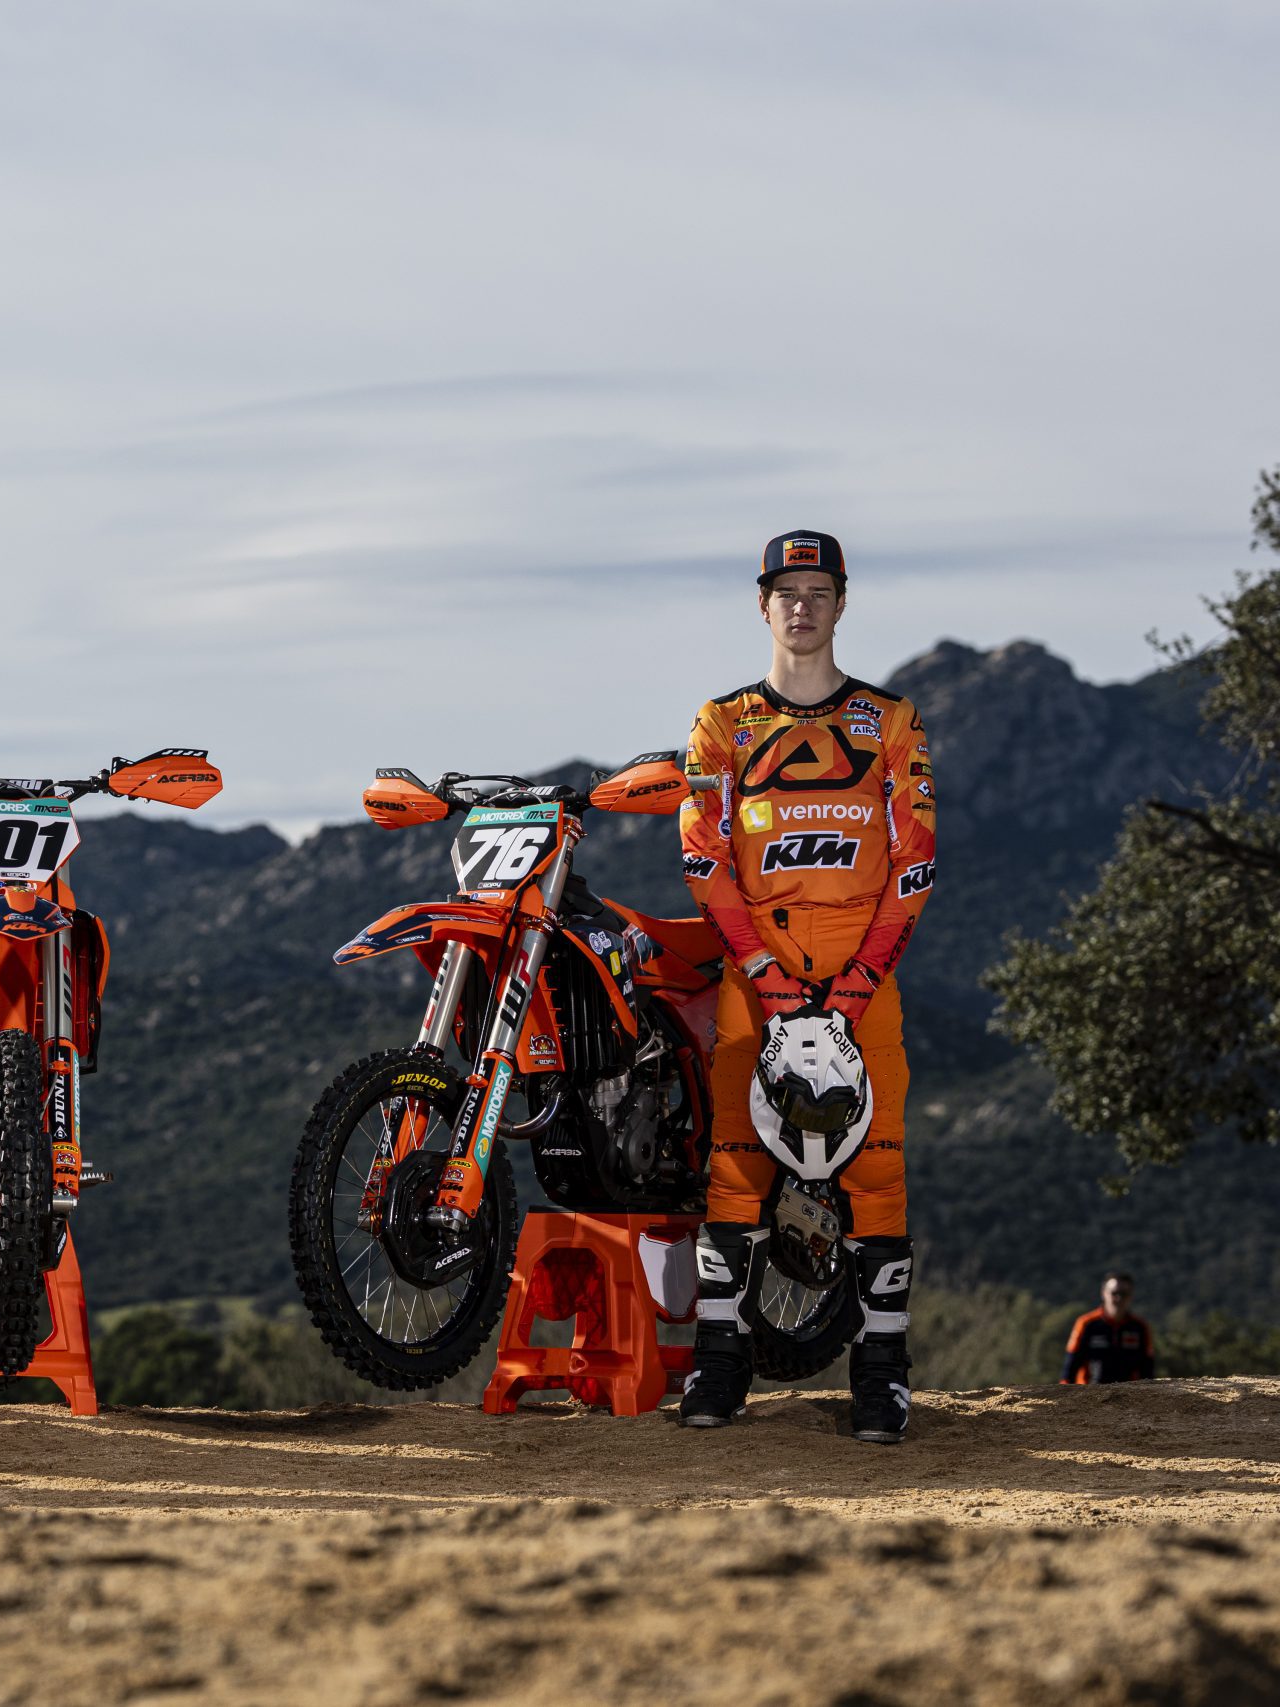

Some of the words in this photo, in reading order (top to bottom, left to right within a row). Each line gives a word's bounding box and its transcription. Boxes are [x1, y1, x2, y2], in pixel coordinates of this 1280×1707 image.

[788, 551, 816, 561] KTM
[847, 698, 884, 720] KTM
[157, 774, 218, 783] ACERBIS
[627, 780, 681, 798] ACERBIS
[34, 804, 69, 813] MXGP
[480, 811, 526, 822] MOTOREX
[526, 810, 556, 820] MX2
[778, 804, 874, 825] venrooy
[463, 827, 550, 881] 716
[760, 830, 861, 875] KTM
[2, 922, 47, 933] KTM
[760, 1024, 789, 1079] AIROH
[823, 1021, 859, 1064] AIROH
[397, 1074, 447, 1091] DUNLOP
[482, 1069, 511, 1138] MOTOREX
[441, 1182, 464, 1192] KTM
[435, 1248, 472, 1270] ACERBIS
